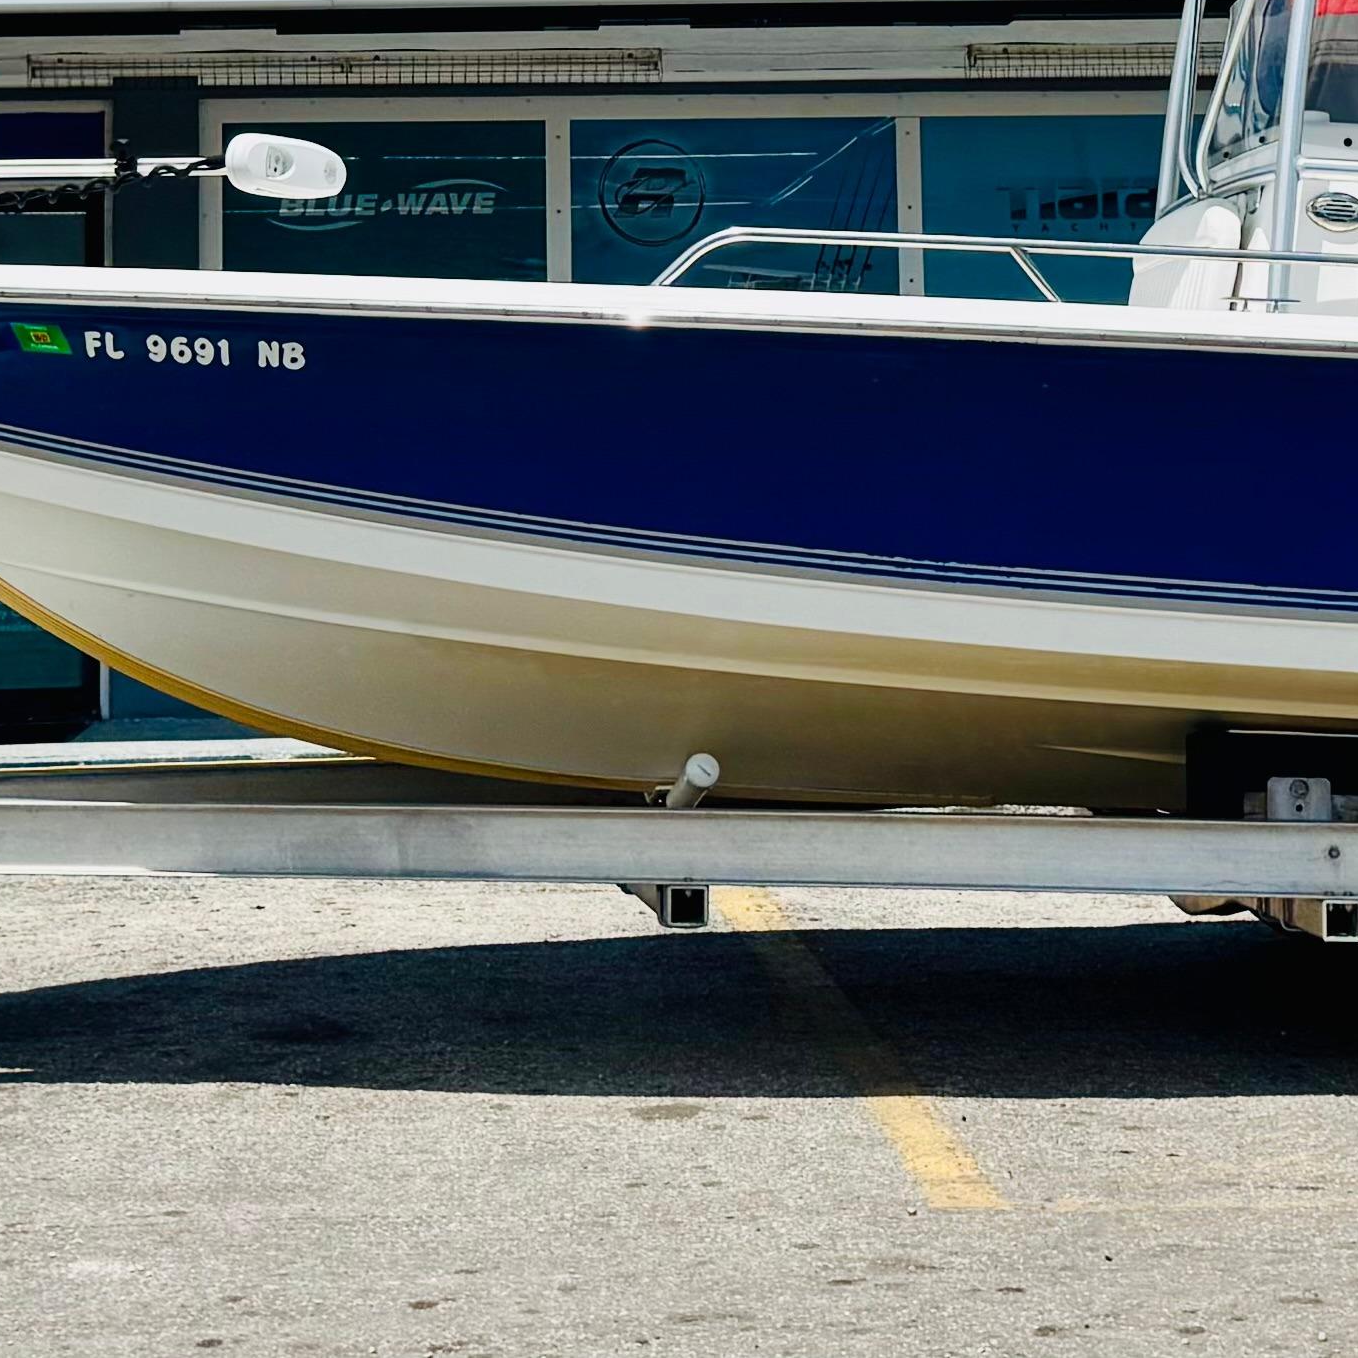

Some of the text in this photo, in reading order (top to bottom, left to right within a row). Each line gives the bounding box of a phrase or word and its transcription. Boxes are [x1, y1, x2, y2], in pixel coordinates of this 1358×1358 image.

[1012, 223, 1137, 233] YACHT
[84, 331, 125, 360] FL
[146, 334, 231, 367] 9691
[258, 340, 306, 371] NB
